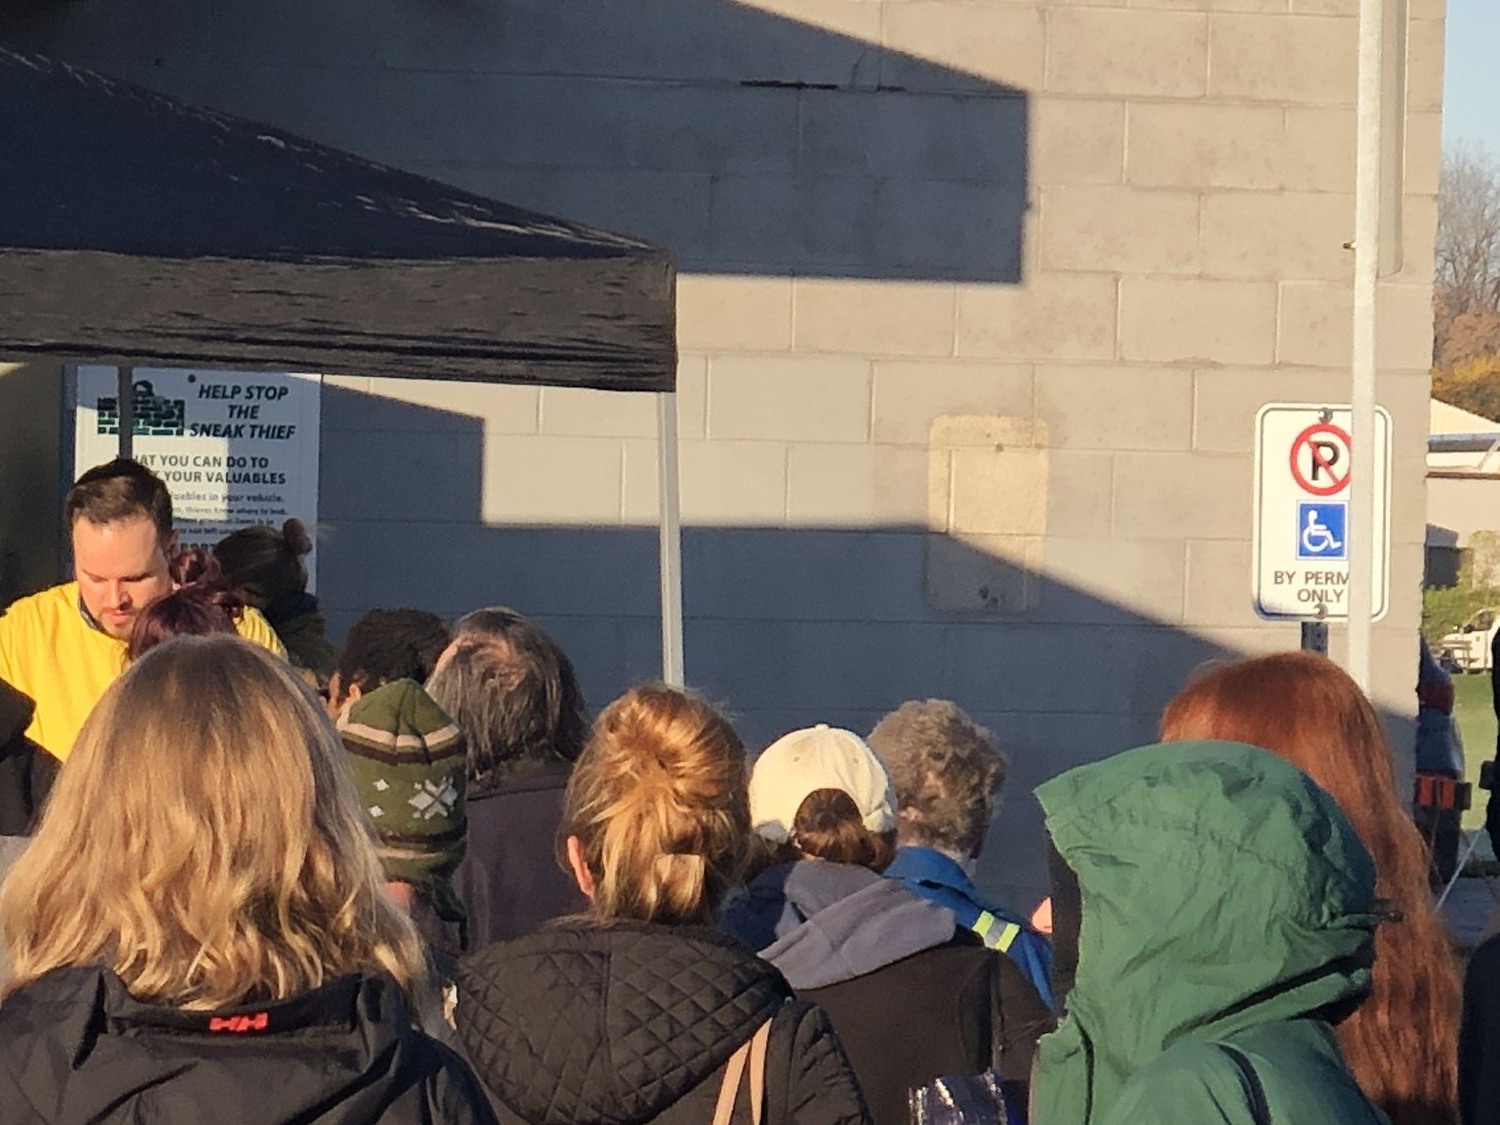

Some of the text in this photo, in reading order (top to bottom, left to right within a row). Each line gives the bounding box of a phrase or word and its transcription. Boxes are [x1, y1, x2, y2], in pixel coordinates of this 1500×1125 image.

[199, 384, 289, 401] HELP STOP
[228, 404, 260, 419] THE
[189, 423, 297, 440] SNEAK THIEF
[161, 454, 190, 467] YOU
[193, 455, 223, 468] CAN
[226, 456, 248, 468] DO
[250, 456, 270, 468] TO
[164, 470, 201, 483] YOUR
[205, 471, 287, 485] VALUABLES
[1274, 570, 1350, 586] BY PERM
[1297, 588, 1344, 604] ONLY
